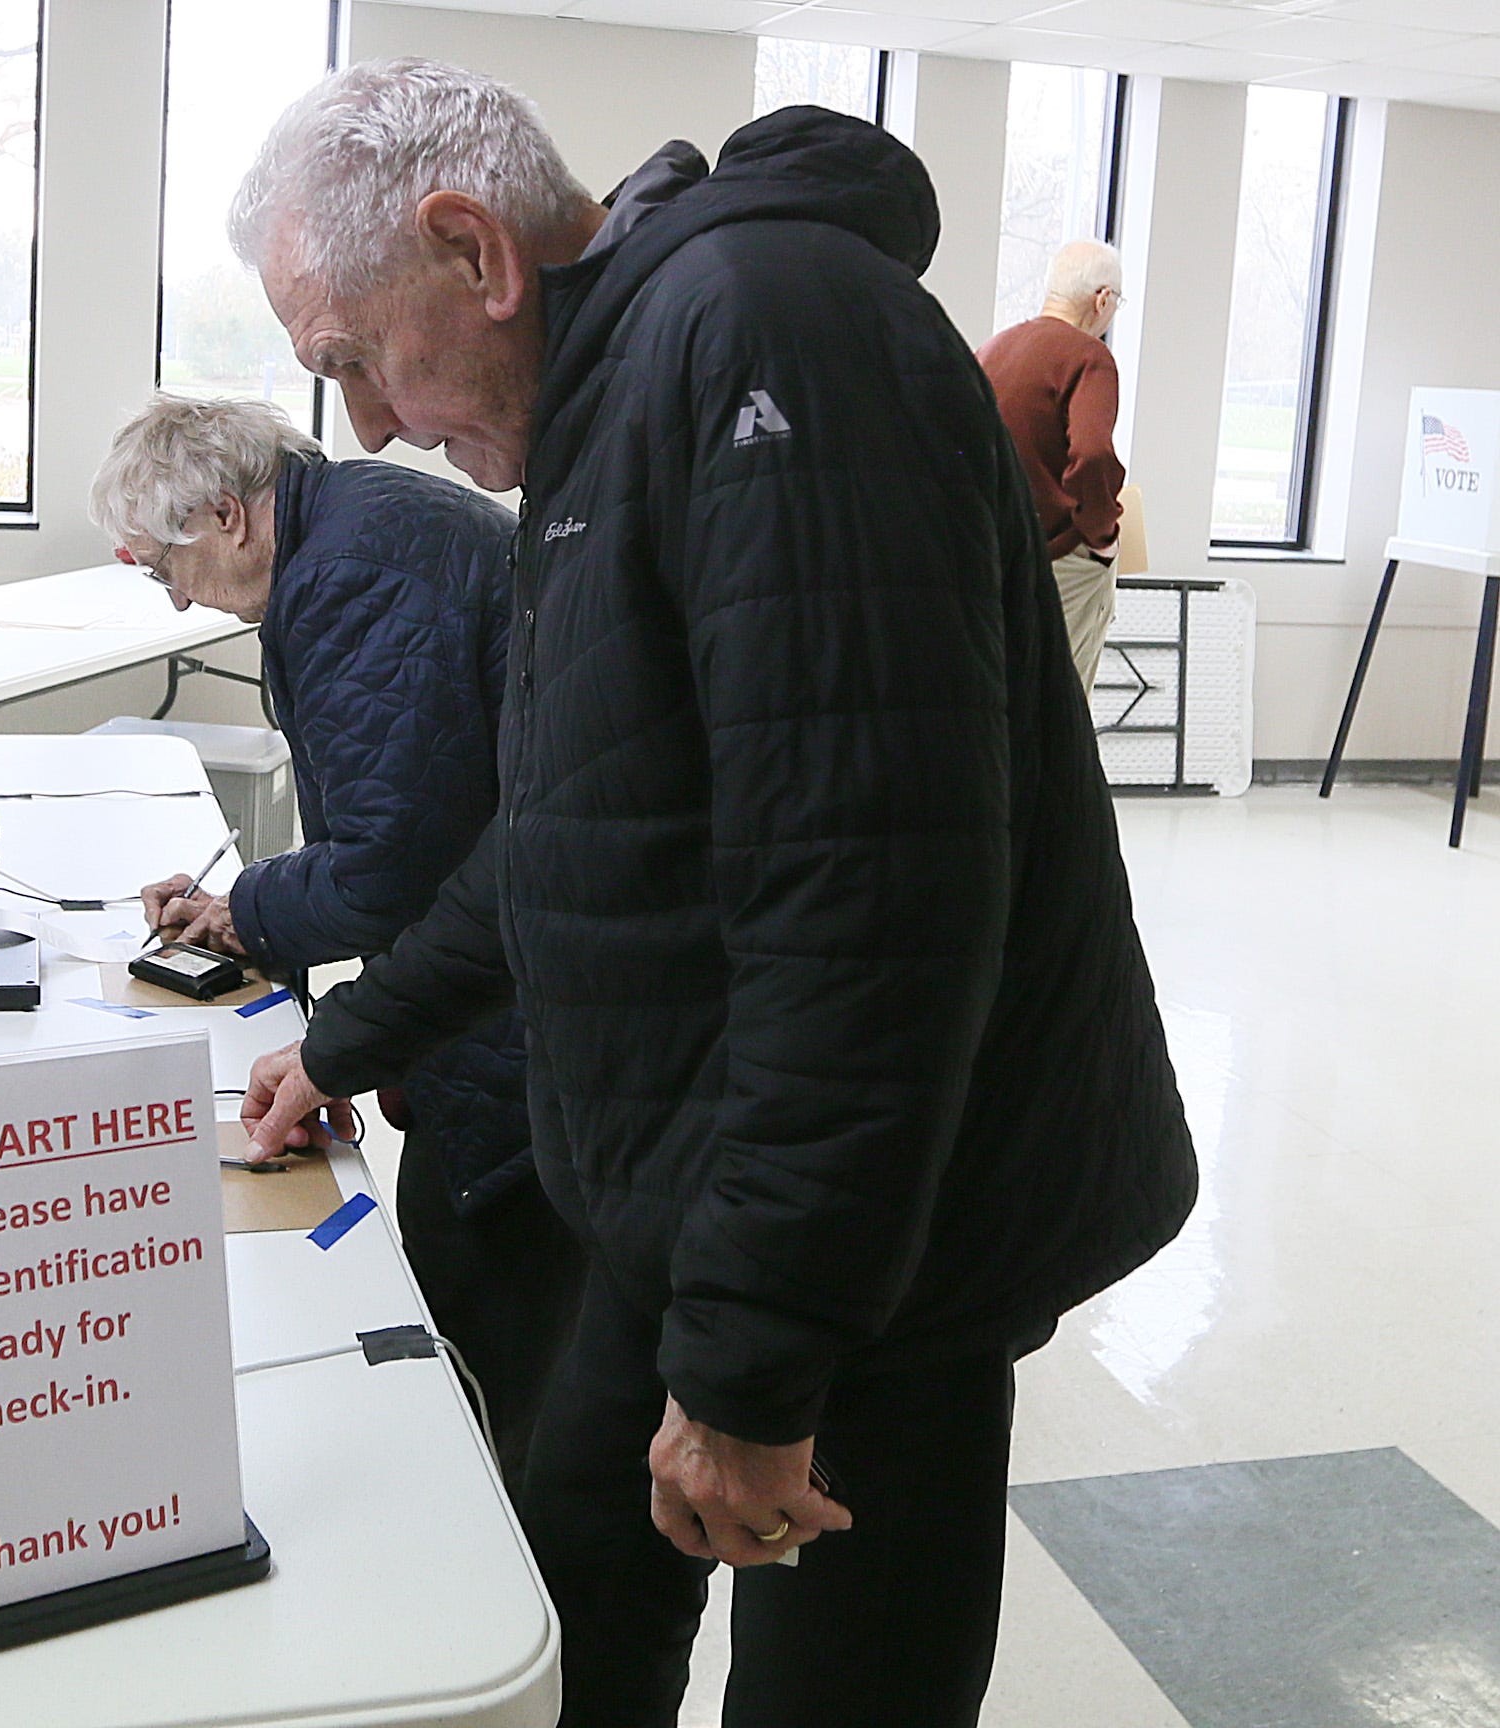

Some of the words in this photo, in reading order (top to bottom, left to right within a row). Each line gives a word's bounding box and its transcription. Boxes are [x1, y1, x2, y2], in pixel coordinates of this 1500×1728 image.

[1435, 467, 1480, 493] VOTE
[92, 1098, 195, 1146] HERE
[84, 1181, 171, 1217] have
[78, 1311, 132, 1344] for
[99, 1493, 182, 1551] you!
